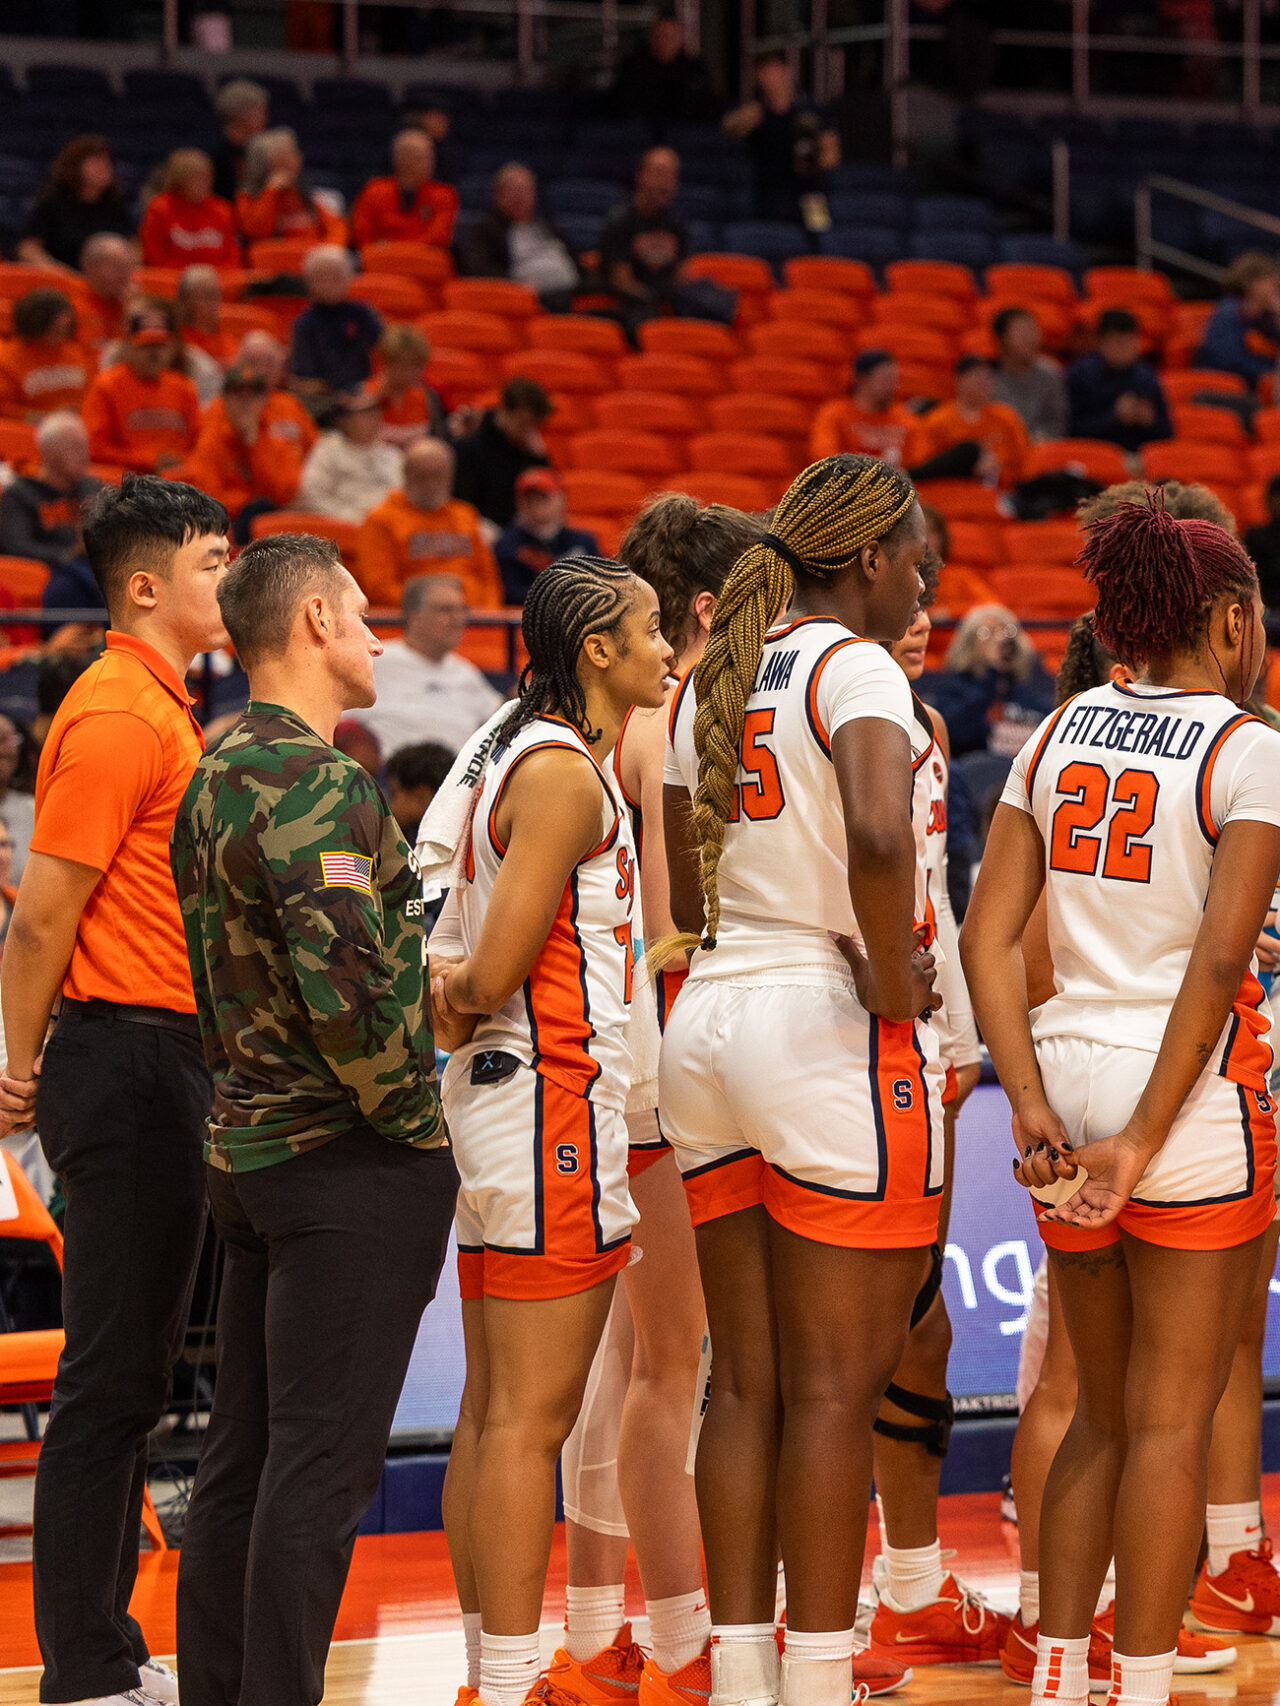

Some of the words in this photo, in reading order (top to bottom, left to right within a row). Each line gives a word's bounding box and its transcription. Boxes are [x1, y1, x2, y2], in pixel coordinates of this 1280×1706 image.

[1058, 705, 1205, 760] FITZGERALD
[727, 707, 786, 823] 5
[1050, 760, 1160, 884] 22
[892, 1078, 913, 1110] S
[556, 1143, 579, 1174] S
